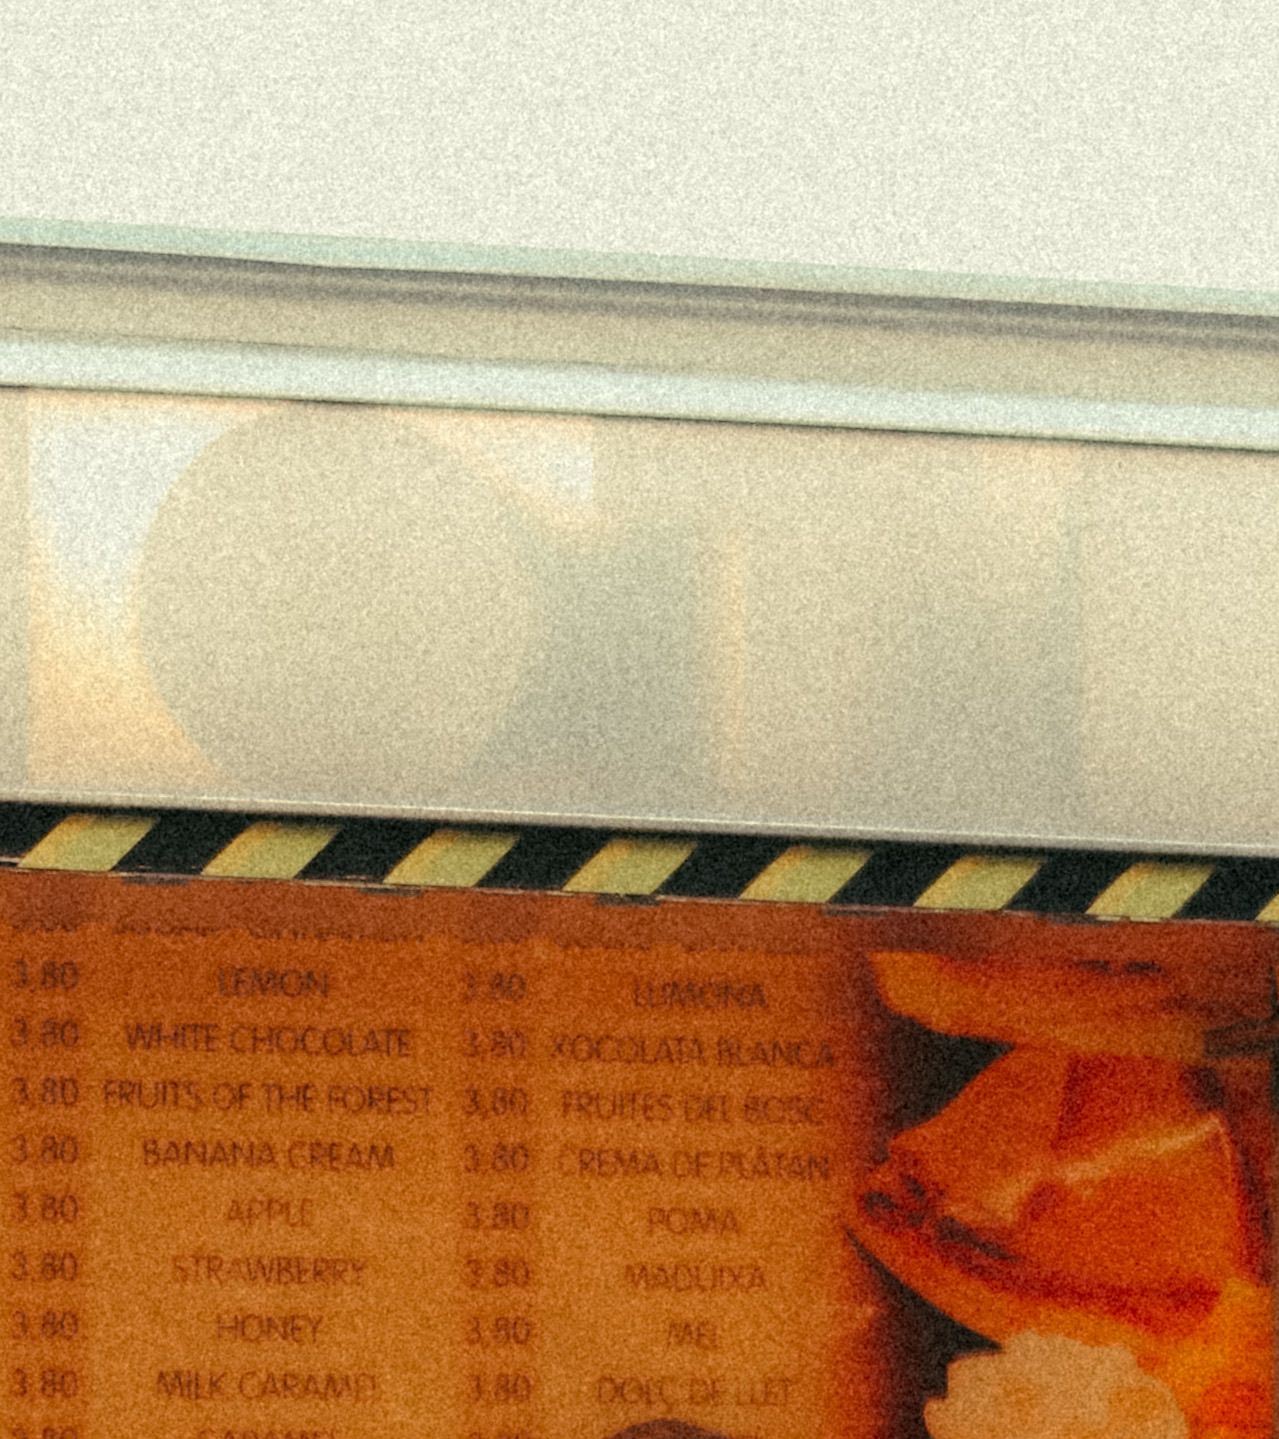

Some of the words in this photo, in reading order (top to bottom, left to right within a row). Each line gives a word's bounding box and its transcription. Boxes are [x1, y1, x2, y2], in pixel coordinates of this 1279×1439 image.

[218, 966, 331, 998] LEMON
[125, 1022, 219, 1052] WHITE
[230, 1024, 412, 1057] CHOCOLATE
[550, 1033, 705, 1065] XOCOLATA
[103, 1079, 202, 1112] FRUITS
[212, 1082, 252, 1112] OF
[265, 1083, 315, 1113] THE
[328, 1085, 432, 1115] FOREST
[142, 1139, 275, 1168] BANANA
[287, 1141, 395, 1172] CREAM
[558, 1147, 662, 1177] CREMA
[672, 1150, 710, 1178] DE
[226, 1197, 312, 1227] APPLE
[648, 1207, 739, 1235] POMA
[173, 1254, 367, 1286] STRAWBERRY
[216, 1314, 322, 1344] HONEY
[156, 1370, 227, 1400] MILK
[239, 1370, 378, 1401] CARAMEL
